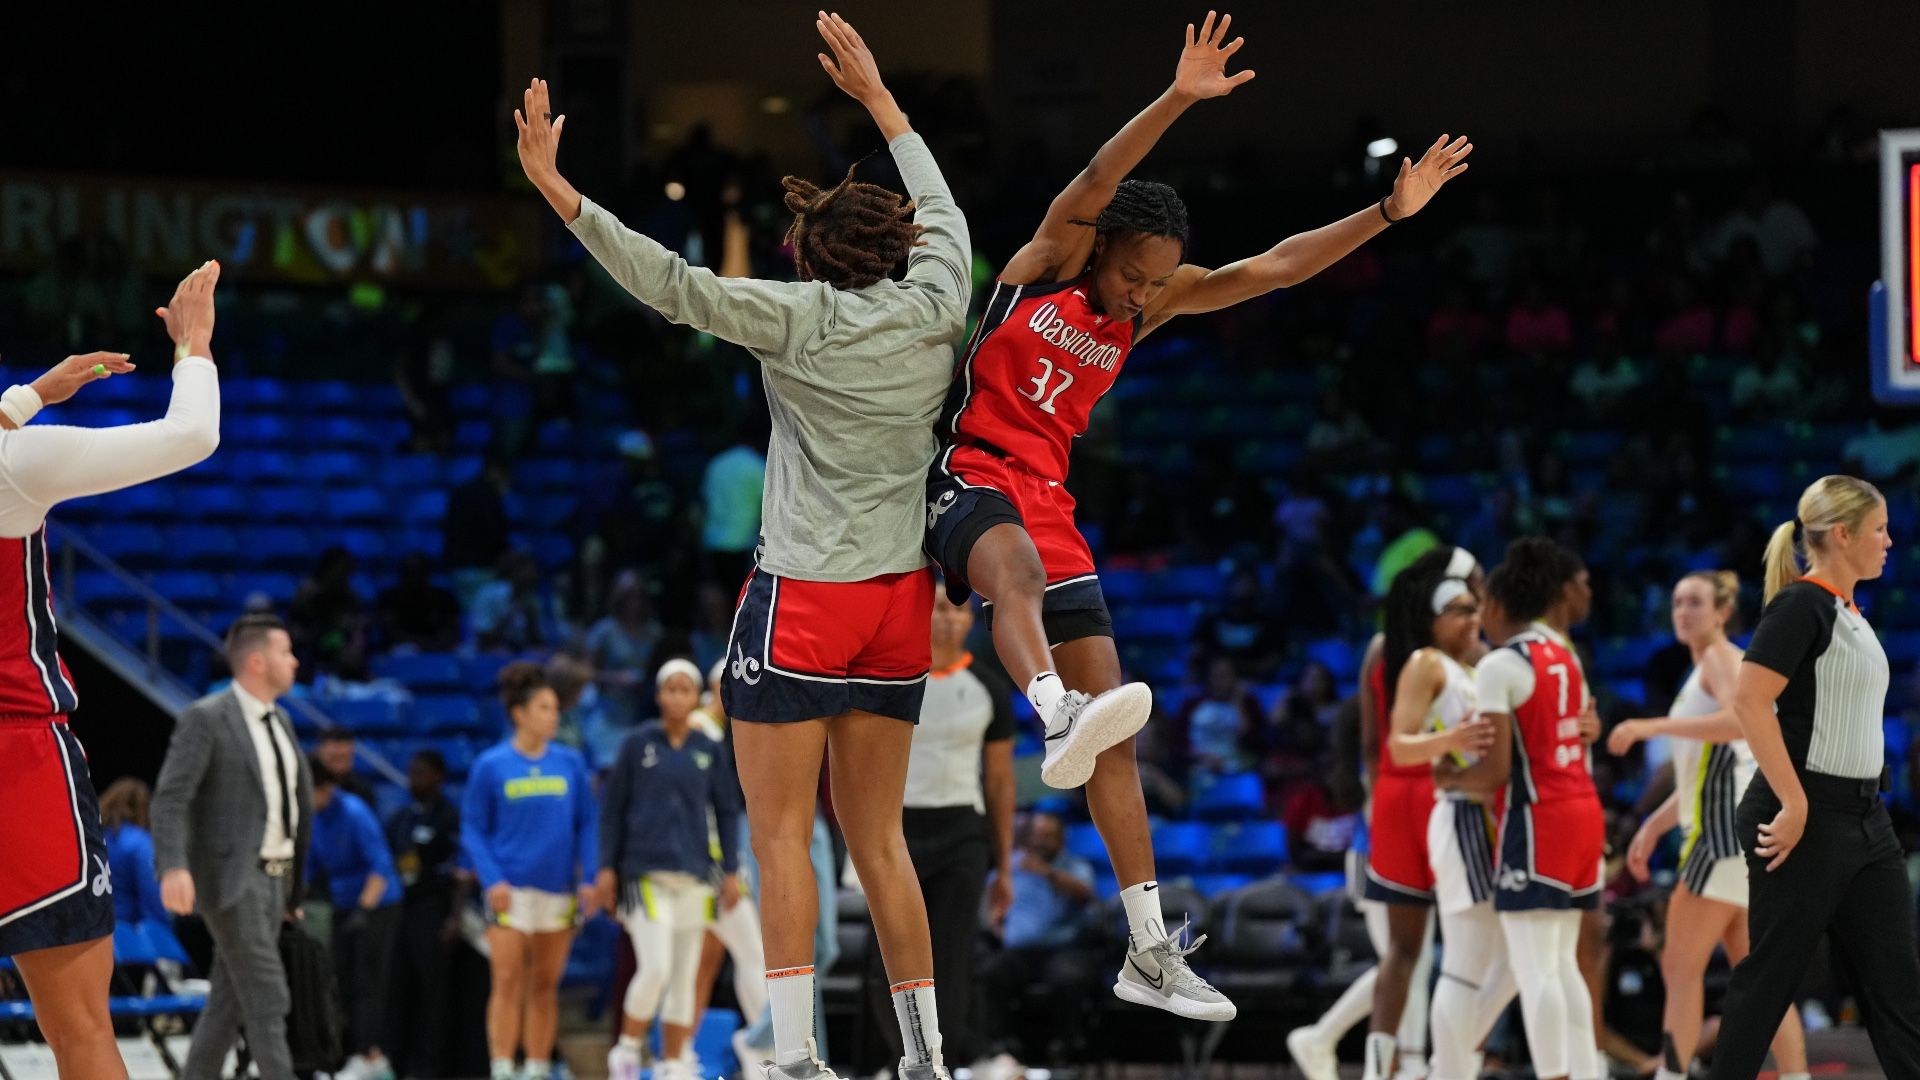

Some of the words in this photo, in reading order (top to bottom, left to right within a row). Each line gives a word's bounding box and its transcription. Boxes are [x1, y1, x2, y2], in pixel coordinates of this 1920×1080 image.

[1028, 301, 1121, 373] Washington
[1017, 357, 1074, 415] 32
[1547, 663, 1569, 716] 7
